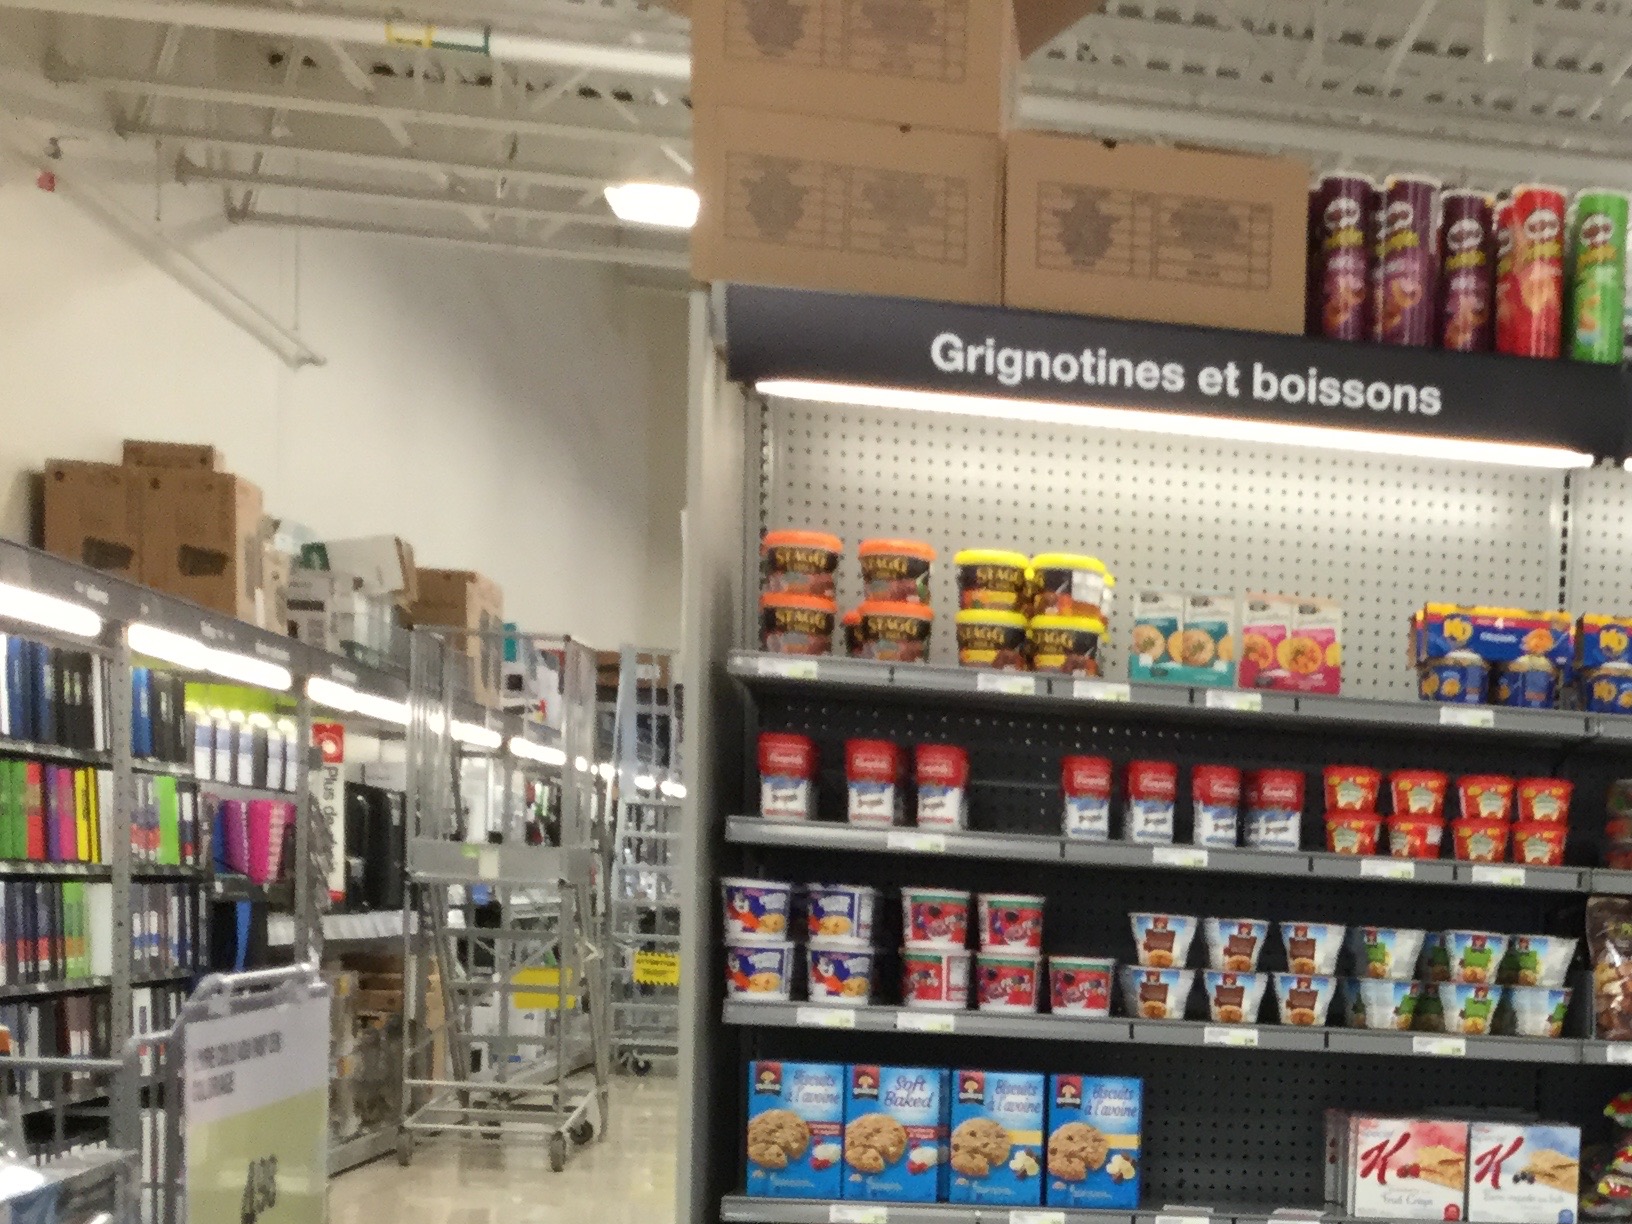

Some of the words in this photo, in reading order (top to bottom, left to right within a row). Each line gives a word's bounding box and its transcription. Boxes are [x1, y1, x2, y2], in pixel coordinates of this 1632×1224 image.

[929, 332, 1186, 394] Grignotines
[1198, 362, 1240, 398] et
[1252, 363, 1443, 416] boissons
[884, 1090, 934, 1108] Baked
[895, 1074, 927, 1097] Soft
[1359, 1132, 1412, 1186] K
[1474, 1136, 1525, 1190] K
